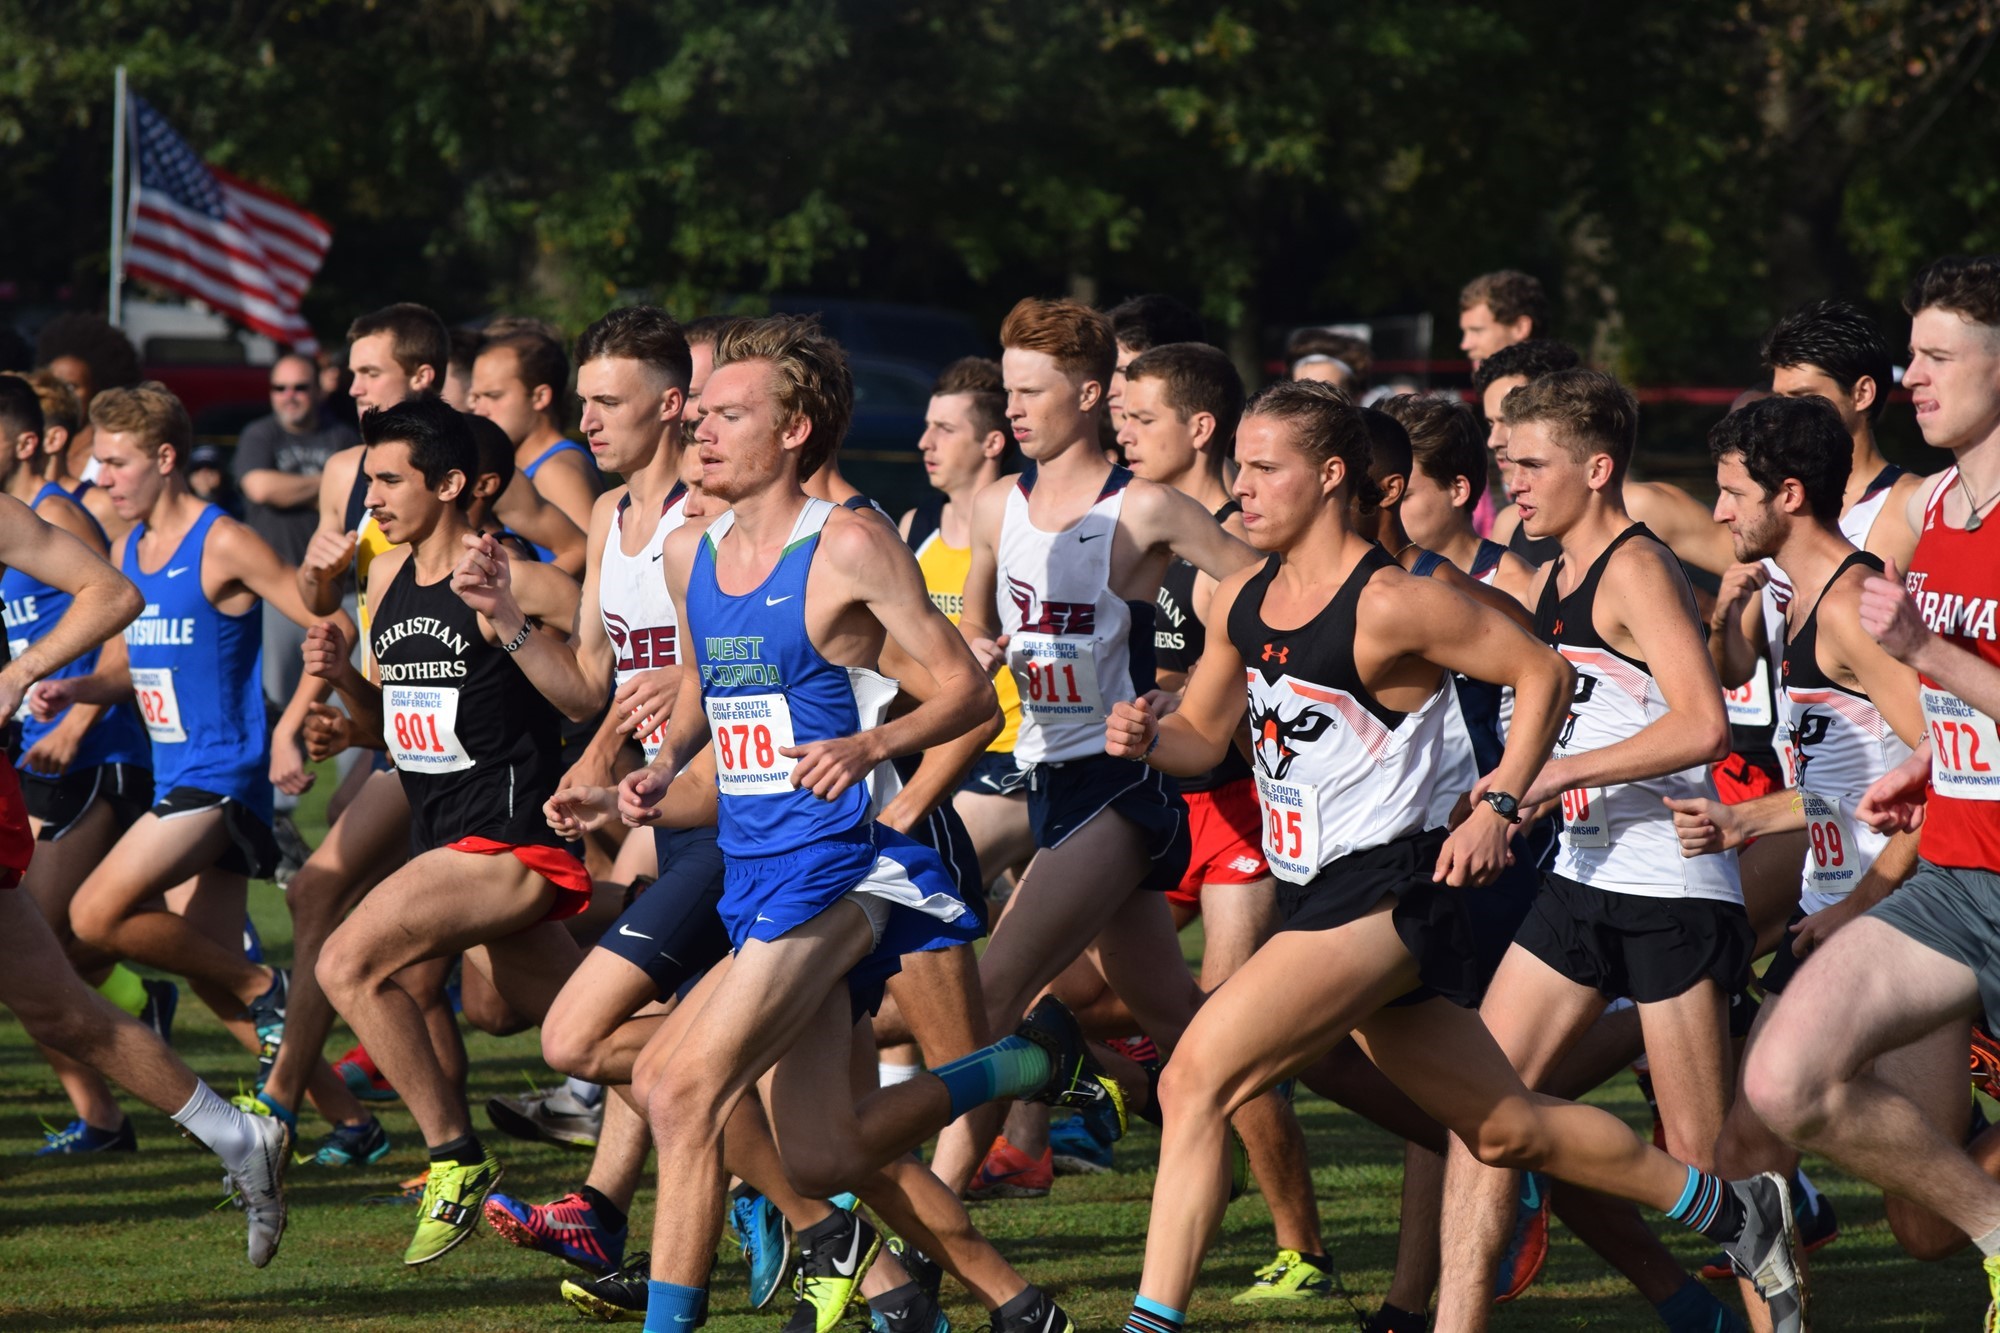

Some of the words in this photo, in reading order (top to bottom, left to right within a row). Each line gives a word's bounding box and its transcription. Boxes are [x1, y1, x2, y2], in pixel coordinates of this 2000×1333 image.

[1906, 571, 1928, 595] EST
[1007, 574, 1096, 635] LEE
[374, 616, 471, 659] CHRISTIAN
[604, 611, 676, 671] LEE
[1023, 641, 1044, 649] GULF
[1046, 642, 1076, 651] SOUTH
[705, 636, 764, 661] WEST
[1022, 649, 1079, 659] CONFERENCE
[378, 660, 467, 681] BROTHERS
[1028, 661, 1082, 703] 811
[135, 689, 169, 723] 82
[391, 699, 442, 708] CONFERENCE
[392, 691, 412, 699] GULF
[414, 692, 441, 700] SOUTH
[712, 702, 732, 711] GULF
[734, 700, 768, 710] SOUTH
[712, 709, 772, 720] CONFERENCE
[1024, 703, 1094, 714] CHAMPIONSHIP
[394, 712, 445, 752] 801
[718, 724, 775, 770] 878
[1931, 720, 1991, 771] 872
[397, 753, 457, 763] CHAMPIONSHIP
[722, 771, 789, 783] CHAMPIONSHIP
[1271, 784, 1300, 797] SOUTH
